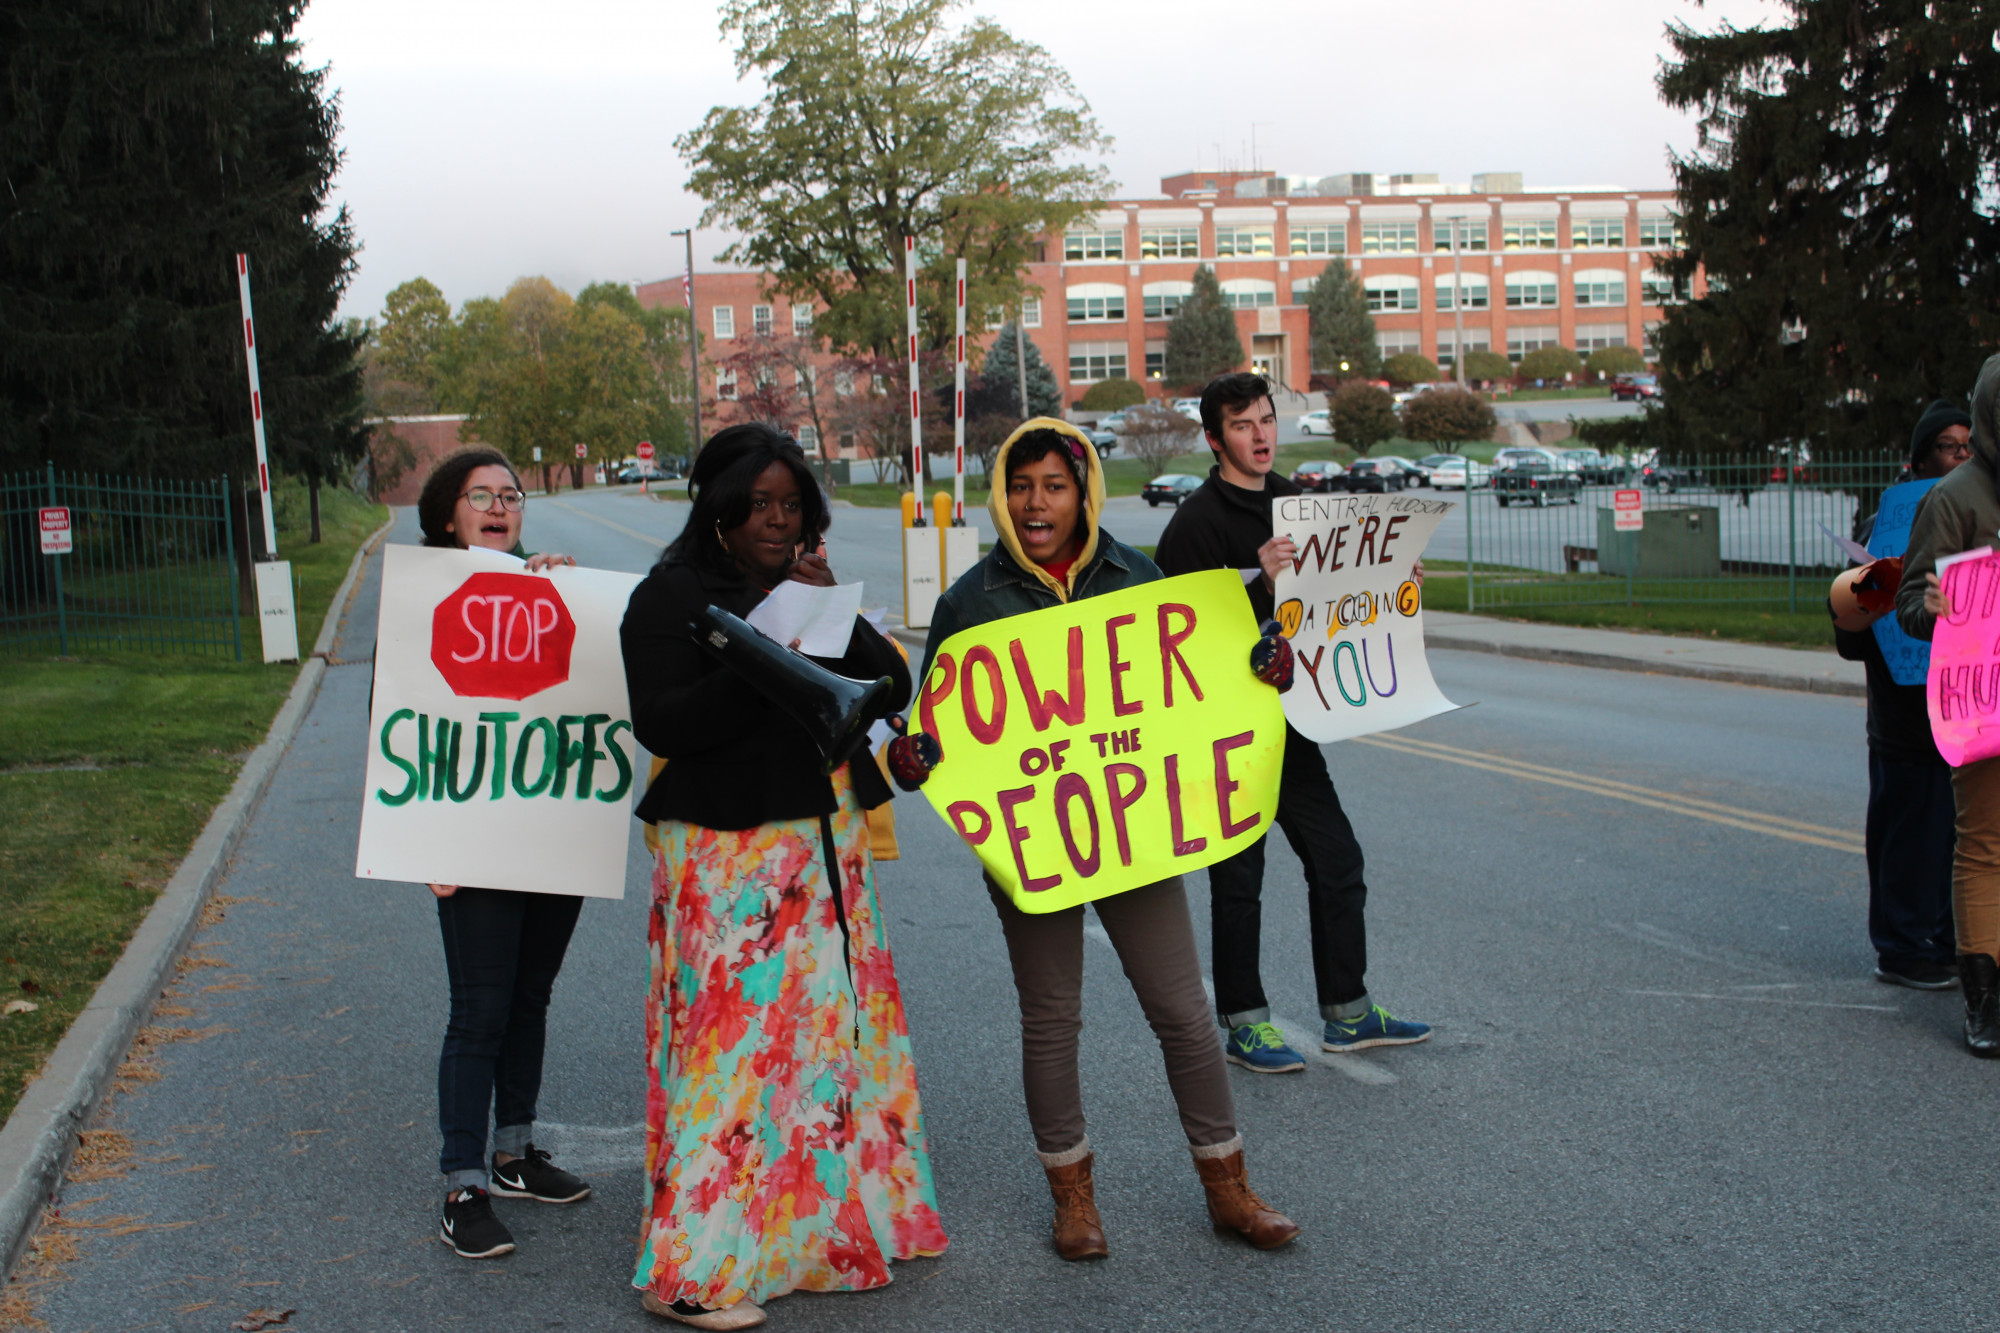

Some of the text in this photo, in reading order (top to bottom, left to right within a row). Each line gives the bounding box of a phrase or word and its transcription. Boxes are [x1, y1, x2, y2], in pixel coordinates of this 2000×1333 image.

[638, 447, 654, 455] STOP
[1280, 495, 1455, 522] CENTRAL HUDSON
[1286, 515, 1411, 576] WE'RE
[451, 594, 559, 663] STOP
[1276, 583, 1417, 634] WATCHING
[919, 602, 1205, 762] POWER
[1297, 632, 1398, 711] YOU
[377, 708, 634, 807] SHUTOFFS
[1020, 728, 1142, 776] OF THE
[947, 730, 1261, 892] PEOPLE
